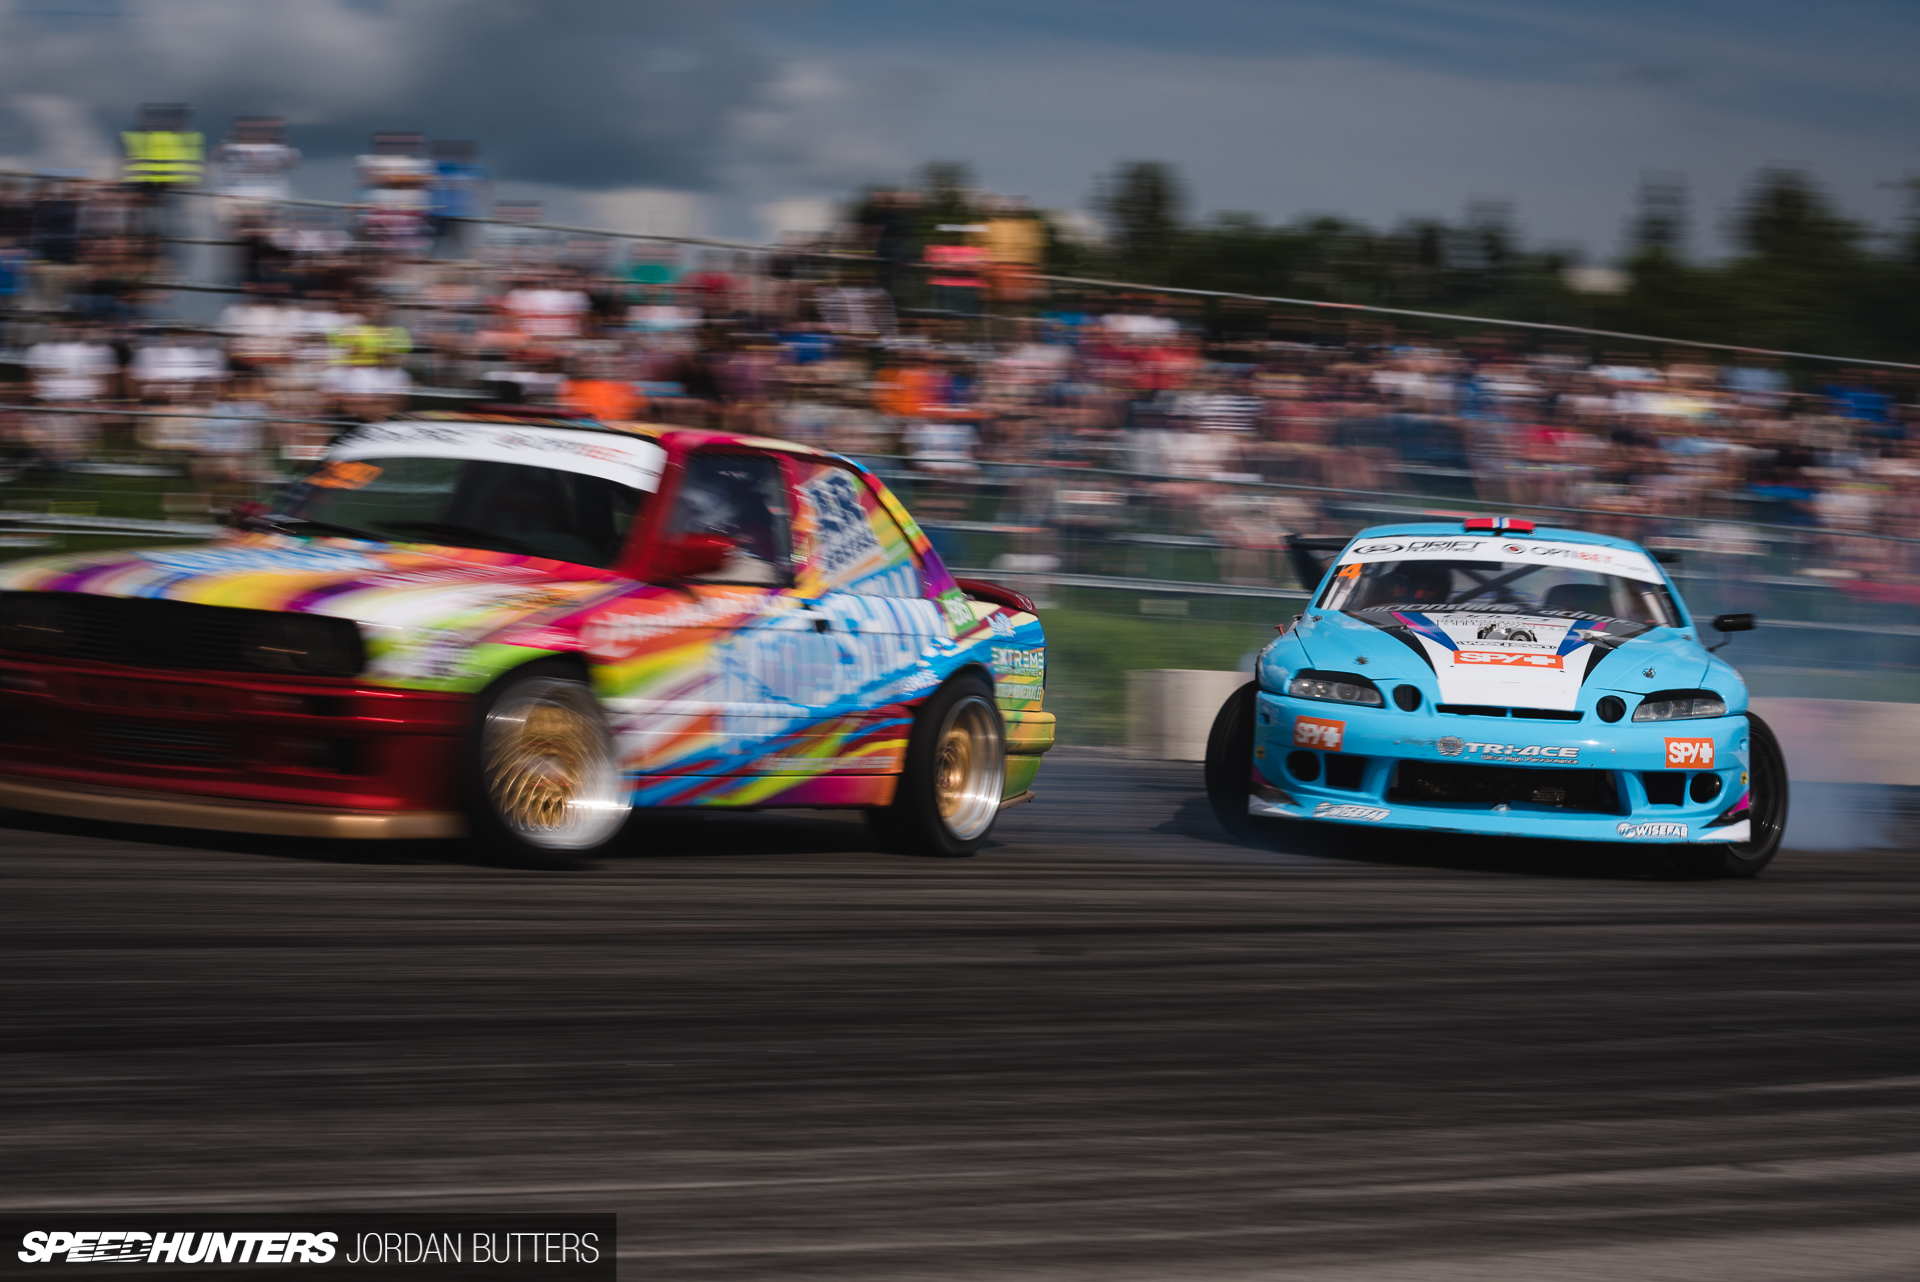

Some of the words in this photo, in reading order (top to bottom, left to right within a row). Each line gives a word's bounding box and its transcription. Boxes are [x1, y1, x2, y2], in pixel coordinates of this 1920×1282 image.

[1407, 541, 1488, 550] DRIFT
[1530, 546, 1613, 563] OPTIBET
[1337, 563, 1363, 580] 4
[990, 646, 1044, 669] EXTREME
[1635, 823, 1688, 839] WISEFAB
